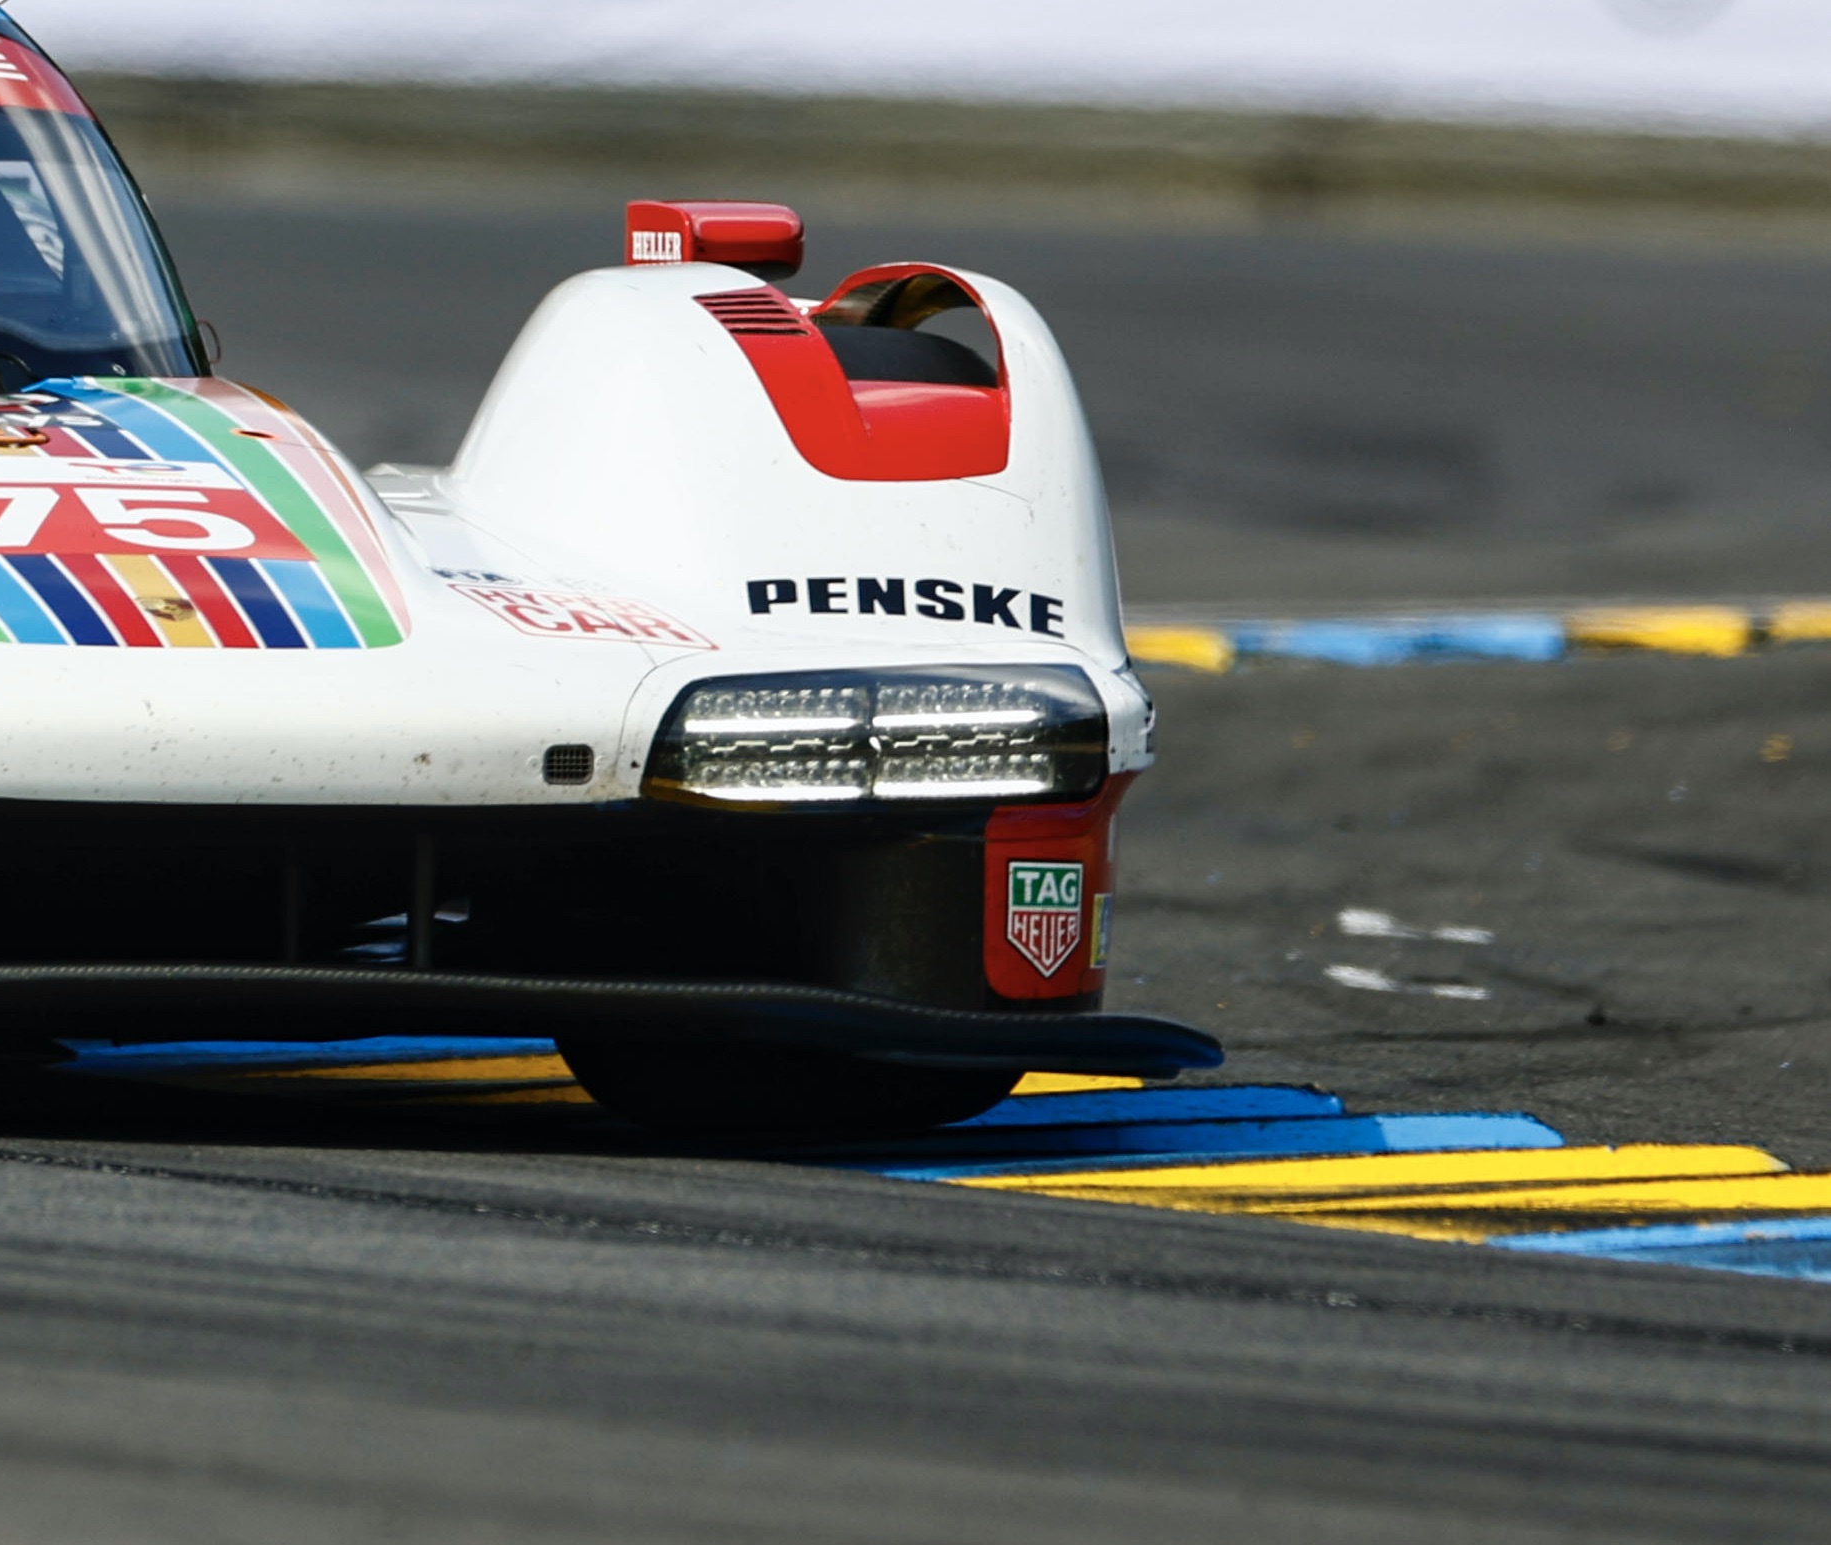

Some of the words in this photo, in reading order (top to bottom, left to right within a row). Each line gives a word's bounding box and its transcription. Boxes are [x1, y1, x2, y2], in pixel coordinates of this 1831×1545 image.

[632, 231, 682, 260] HELLER
[502, 605, 695, 643] CAR
[746, 577, 1064, 639] PENSKE
[1016, 870, 1077, 904] TAG
[1014, 913, 1077, 967] HEUER
